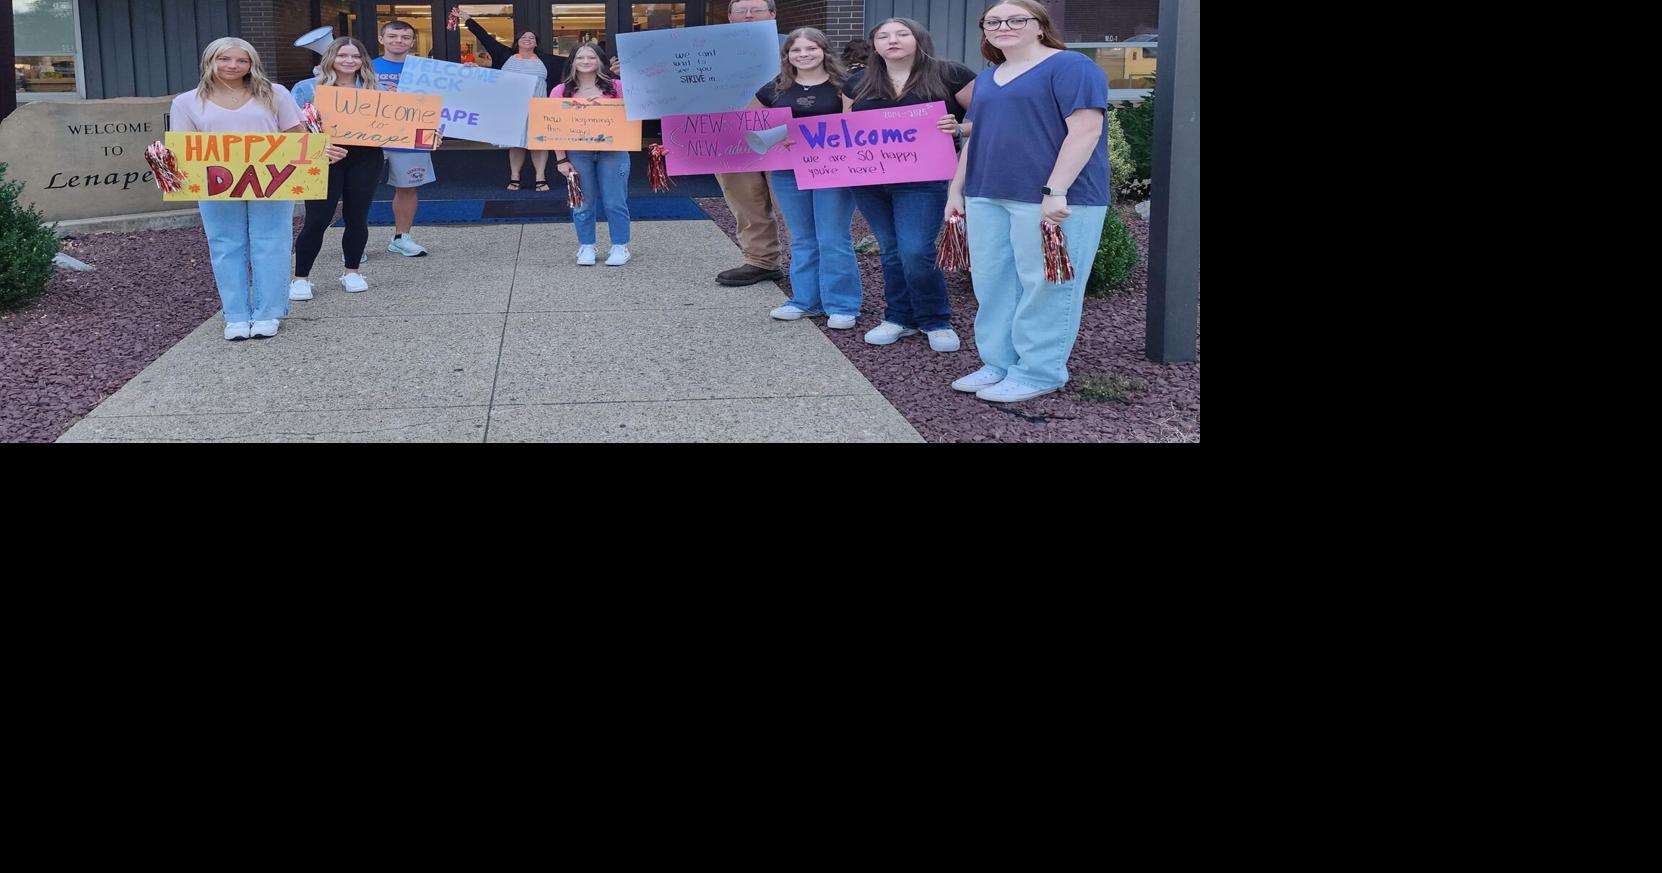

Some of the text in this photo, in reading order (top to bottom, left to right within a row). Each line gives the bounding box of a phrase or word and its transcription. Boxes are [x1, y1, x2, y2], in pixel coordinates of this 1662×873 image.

[404, 57, 499, 83] WELCOME
[680, 74, 706, 84] STRIVE
[696, 66, 713, 74] you
[400, 71, 465, 92] BACK
[334, 90, 436, 124] Welcome
[440, 107, 480, 126] APE
[67, 122, 153, 135] WELCOME
[368, 119, 389, 130] to
[684, 109, 771, 134] NEW YEAR
[330, 124, 411, 147] Lenape
[798, 118, 918, 150] Welcome
[102, 145, 124, 157] TO
[185, 134, 287, 163] HAPPY
[687, 140, 719, 157] NEW
[803, 149, 918, 164] we are SO happy
[43, 170, 155, 191] Lenape
[206, 164, 297, 199] DAY
